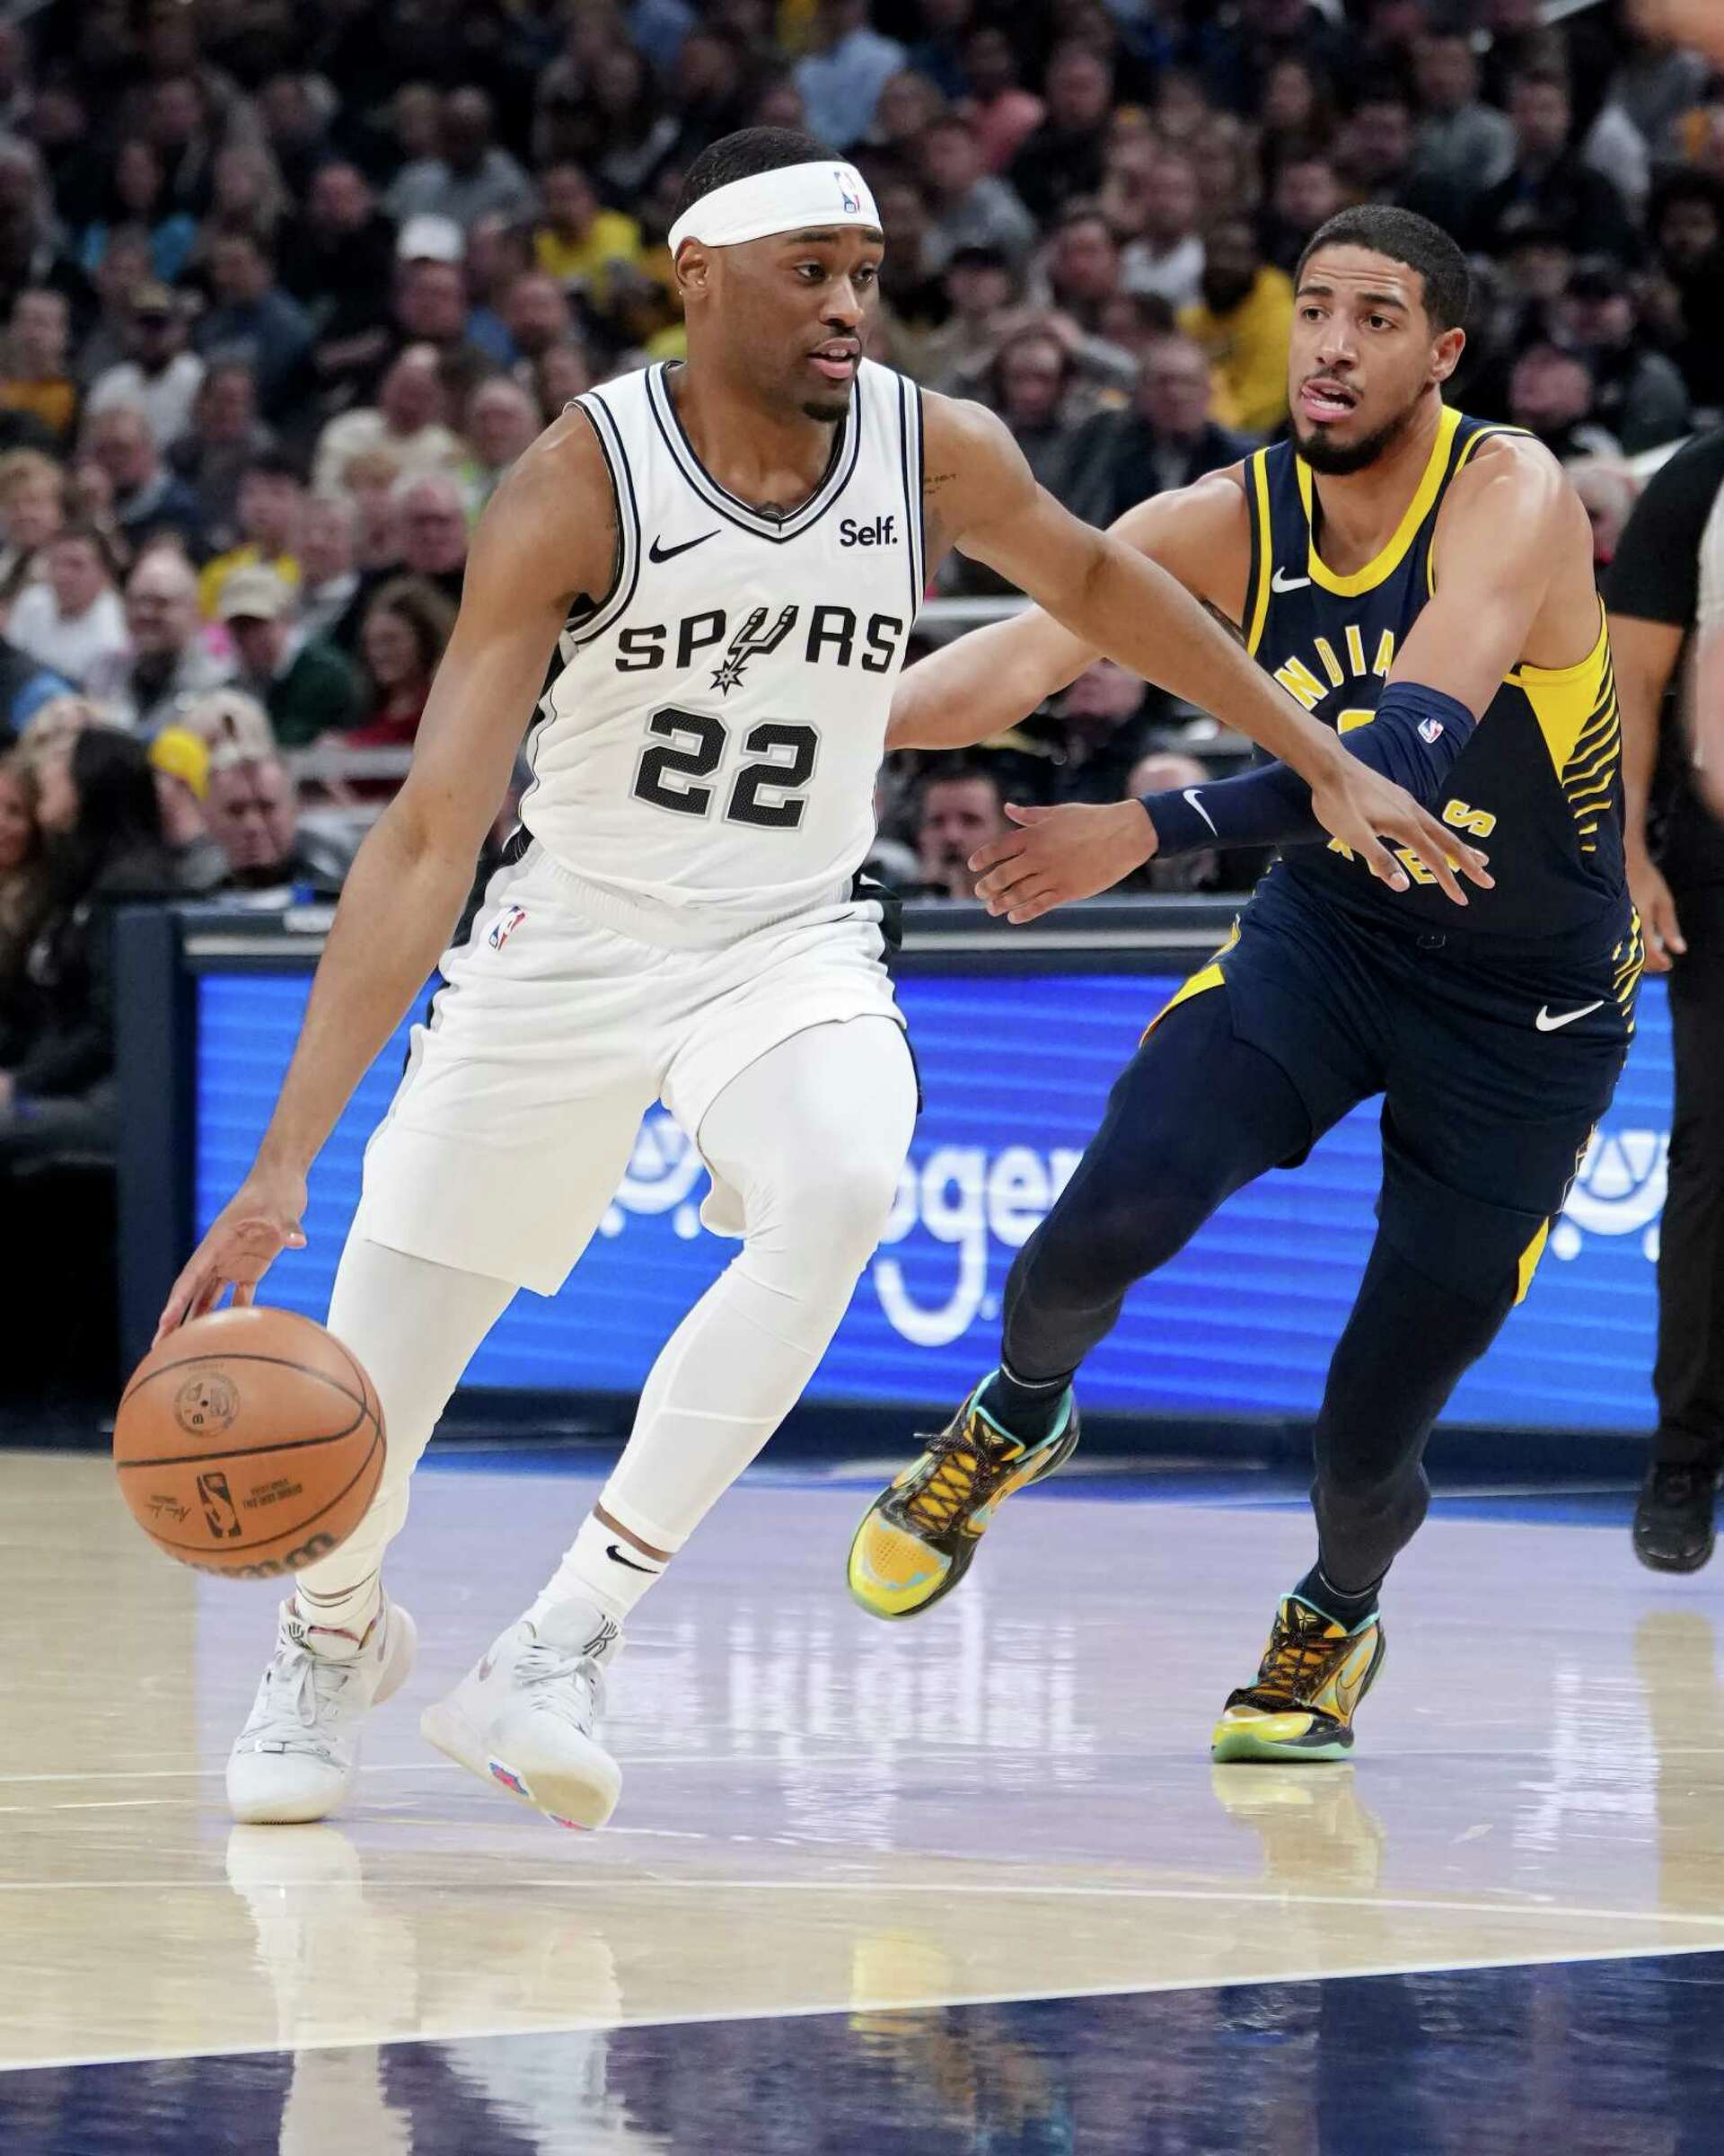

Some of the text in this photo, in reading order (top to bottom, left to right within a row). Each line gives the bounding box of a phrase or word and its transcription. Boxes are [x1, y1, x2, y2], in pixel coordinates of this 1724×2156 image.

[840, 515, 898, 547] Self.
[615, 604, 903, 696] SPURS
[632, 703, 822, 831] 22
